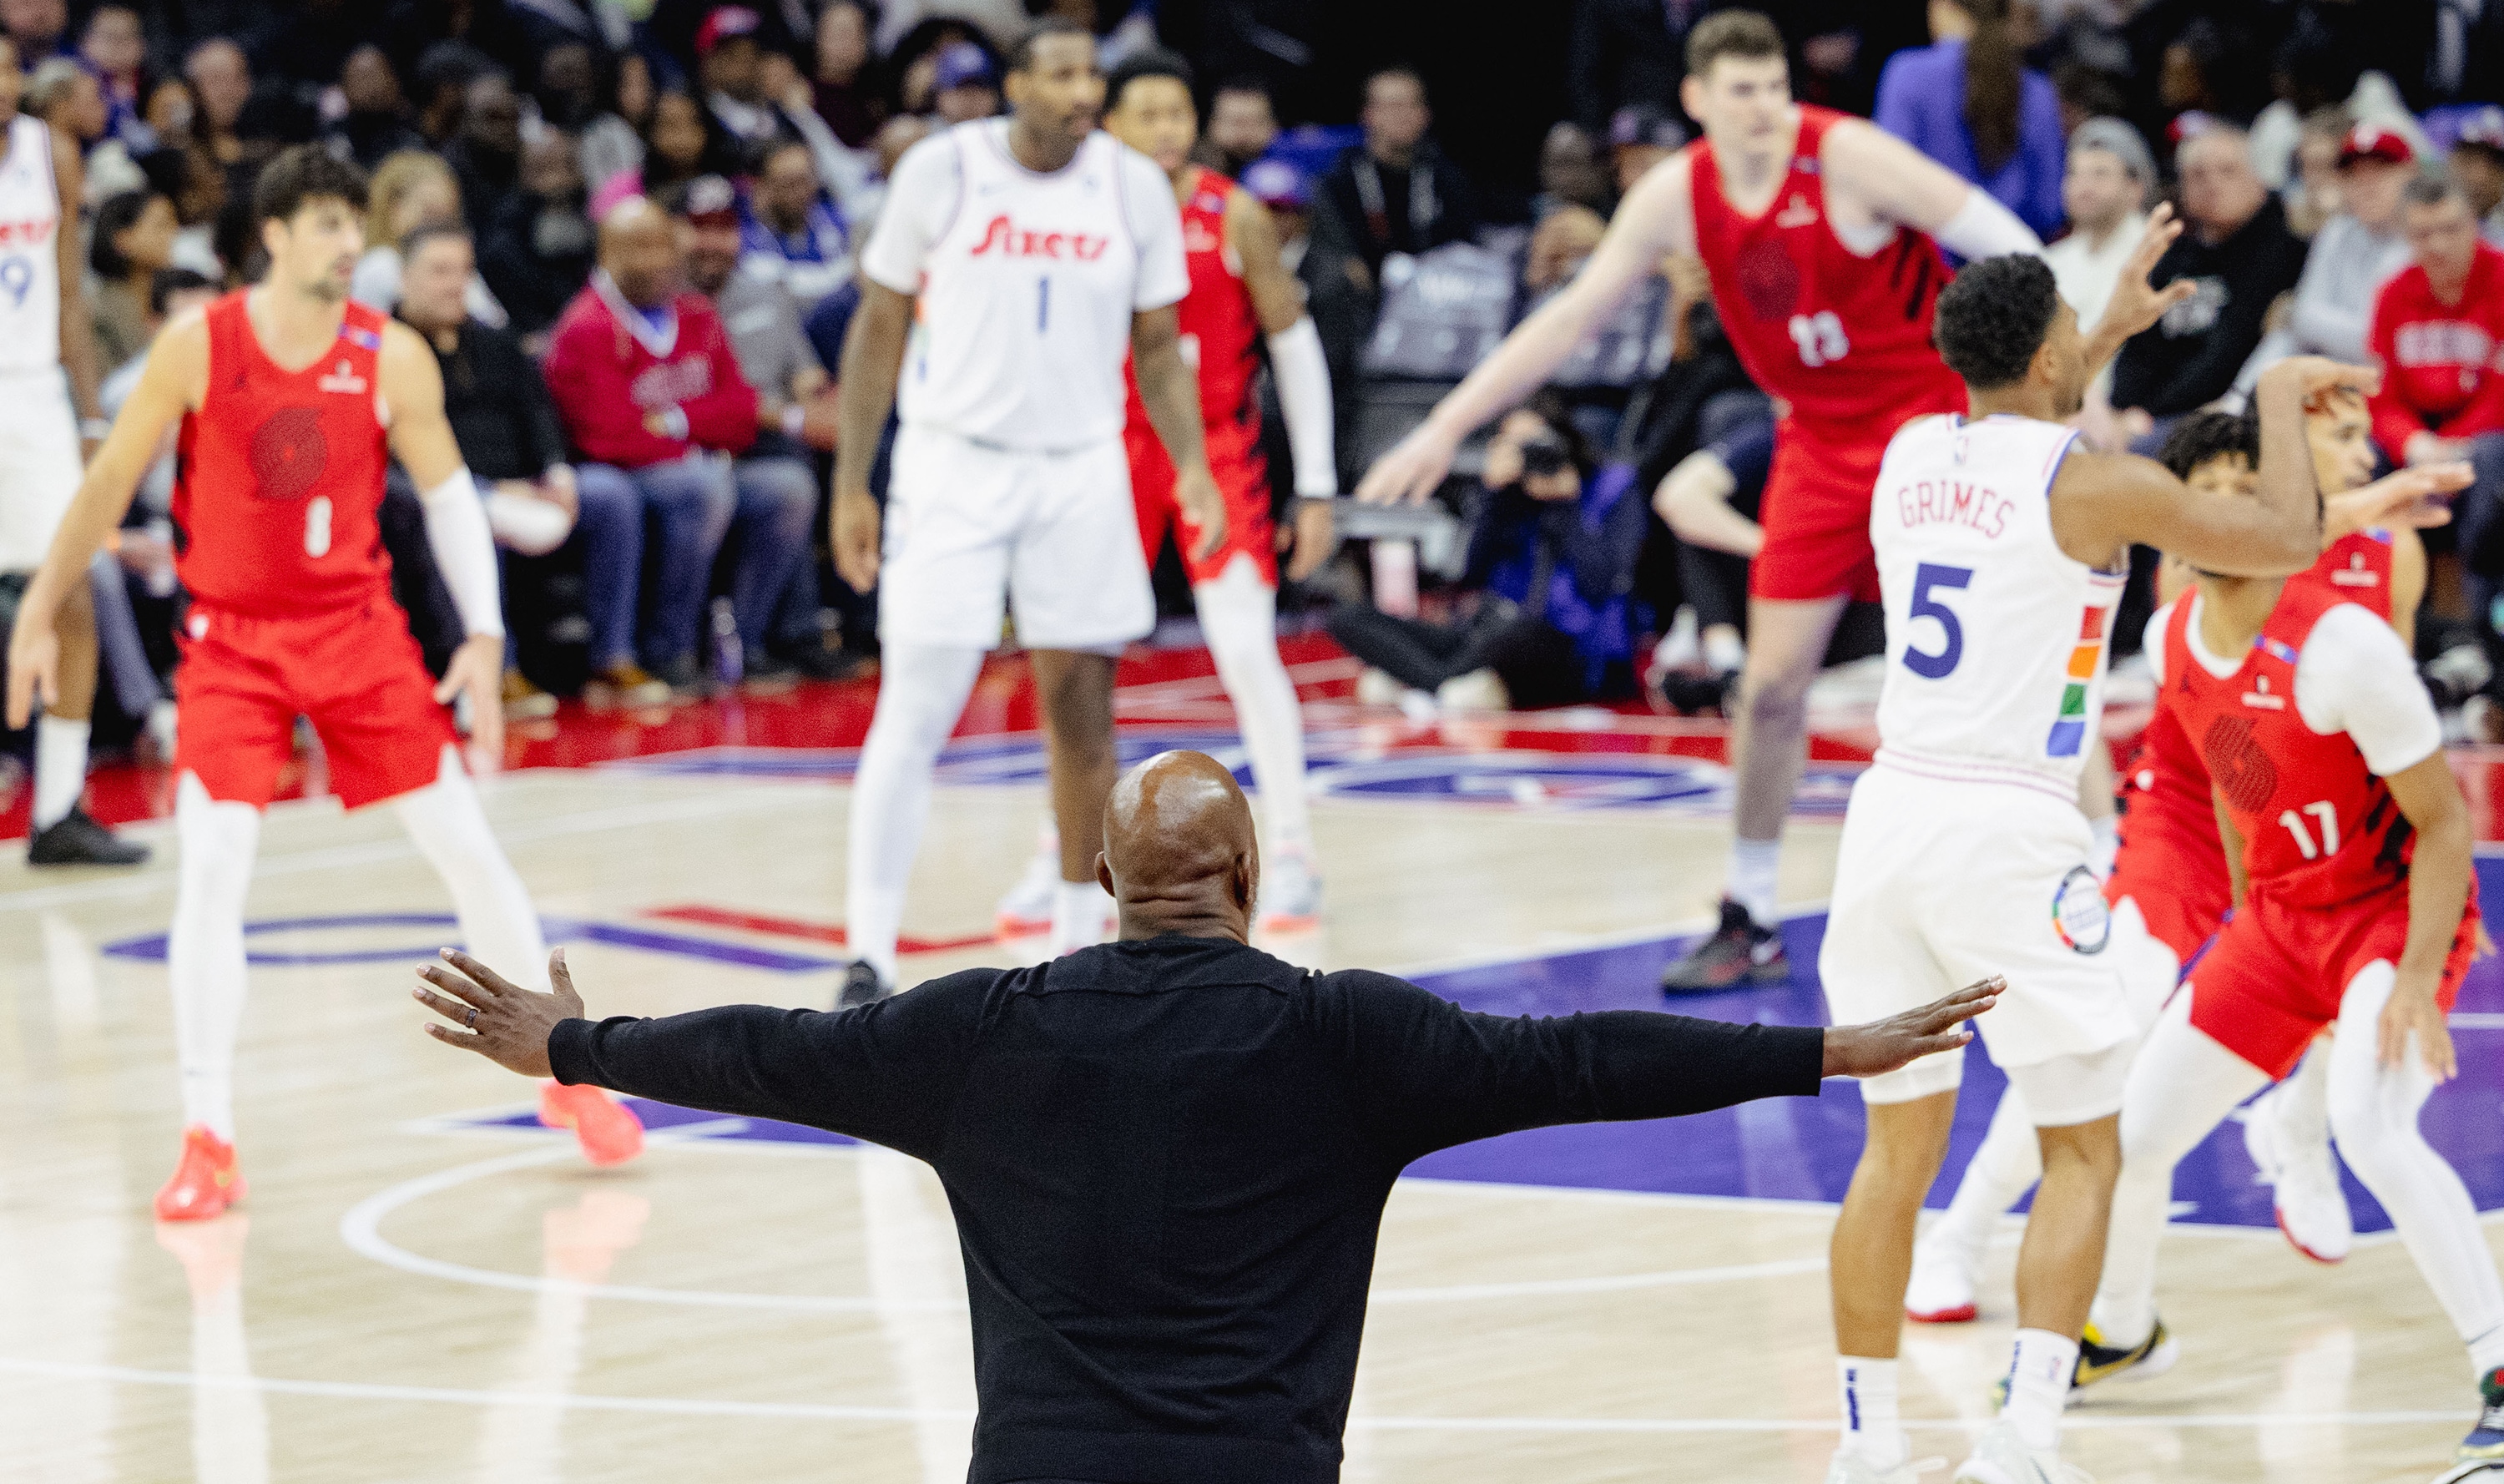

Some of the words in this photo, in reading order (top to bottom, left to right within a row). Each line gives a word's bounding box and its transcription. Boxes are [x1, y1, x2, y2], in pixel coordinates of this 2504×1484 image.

[0, 254, 33, 309] 9
[1036, 274, 1051, 334] 1
[1897, 479, 2017, 539] GRIMES
[1902, 561, 1976, 680] 5
[2279, 800, 2340, 860] 17
